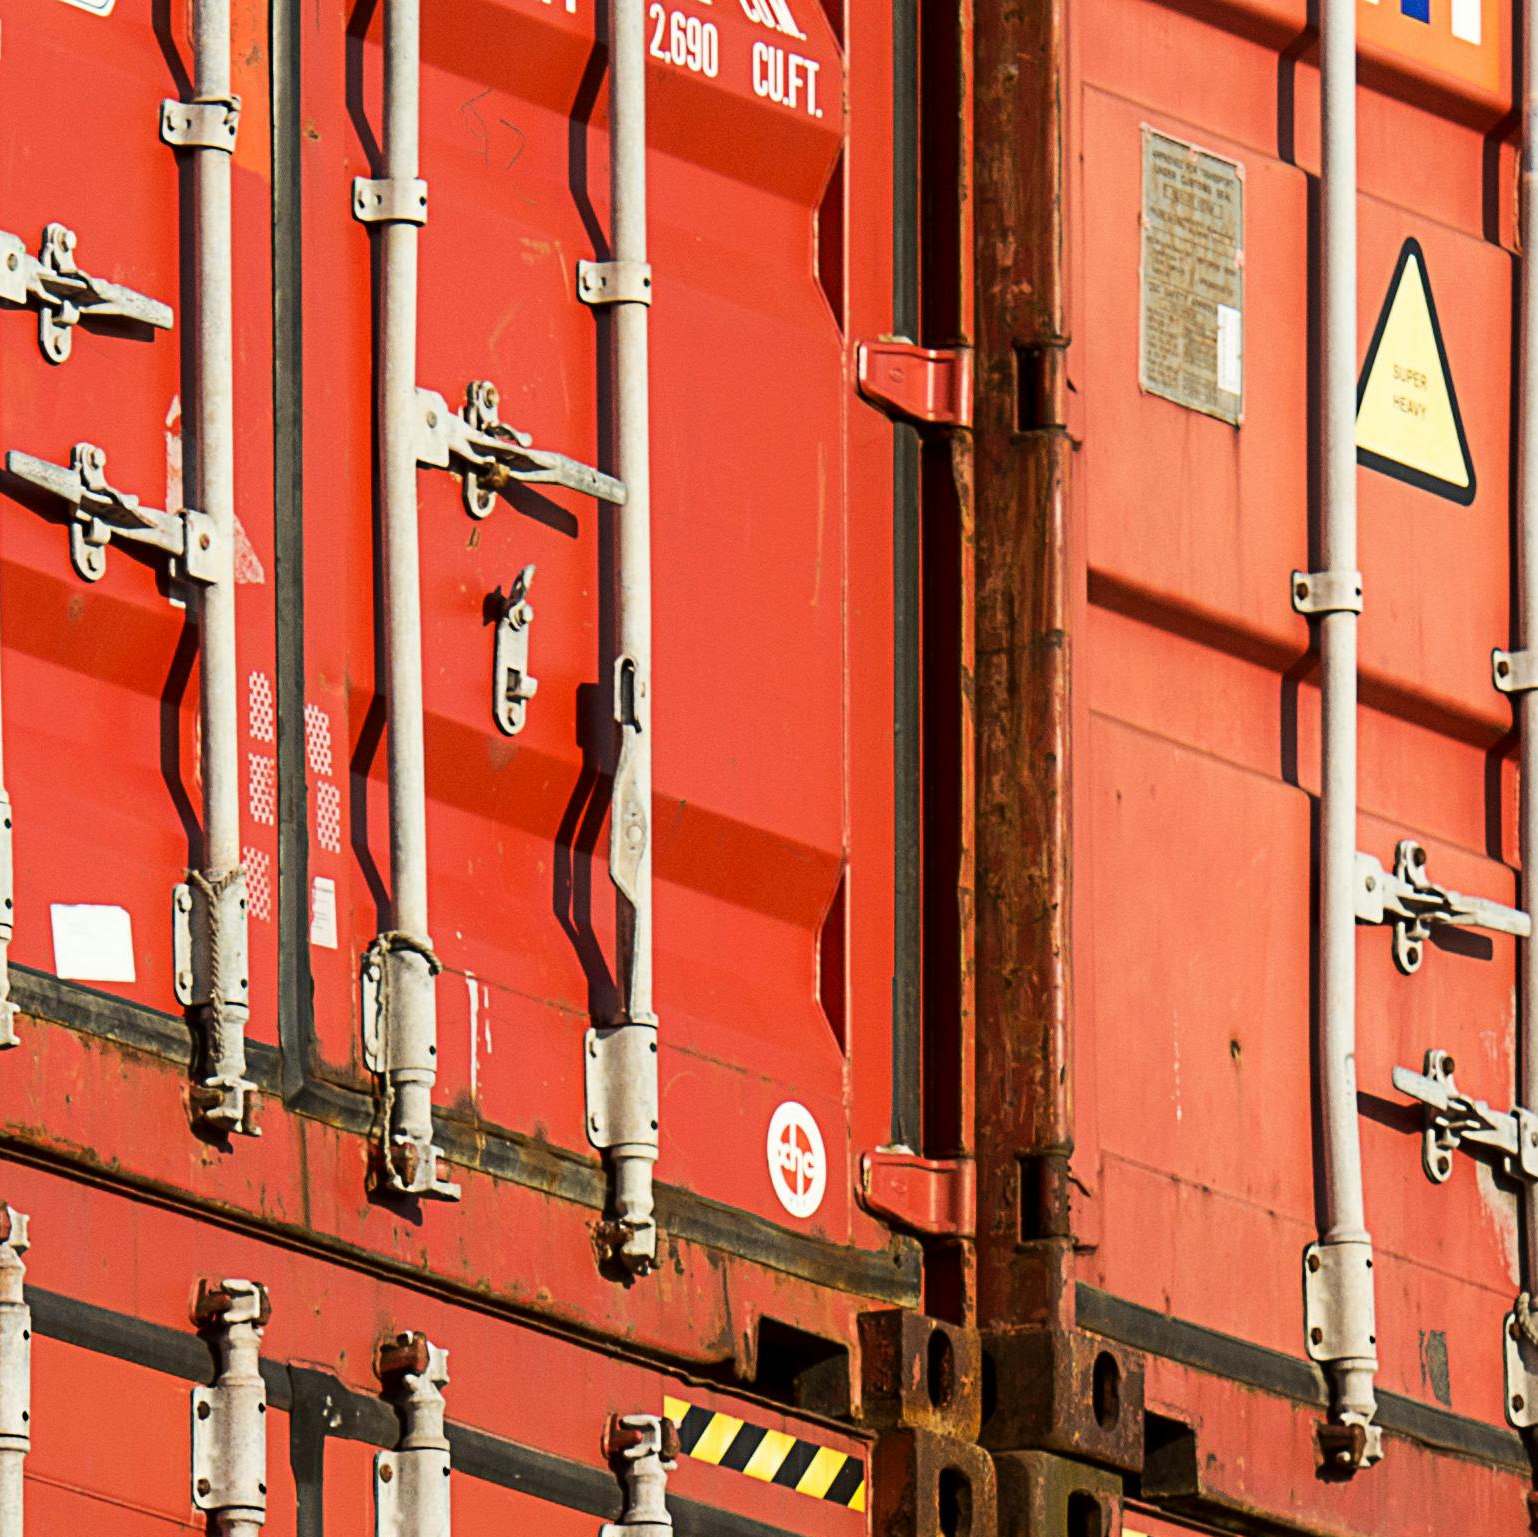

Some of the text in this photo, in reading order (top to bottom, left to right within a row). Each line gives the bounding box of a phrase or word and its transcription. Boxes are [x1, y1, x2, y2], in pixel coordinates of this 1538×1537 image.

[752, 41, 823, 119] CU.FT.
[1391, 364, 1429, 392] SUPER
[1392, 394, 1428, 422] HEAVY
